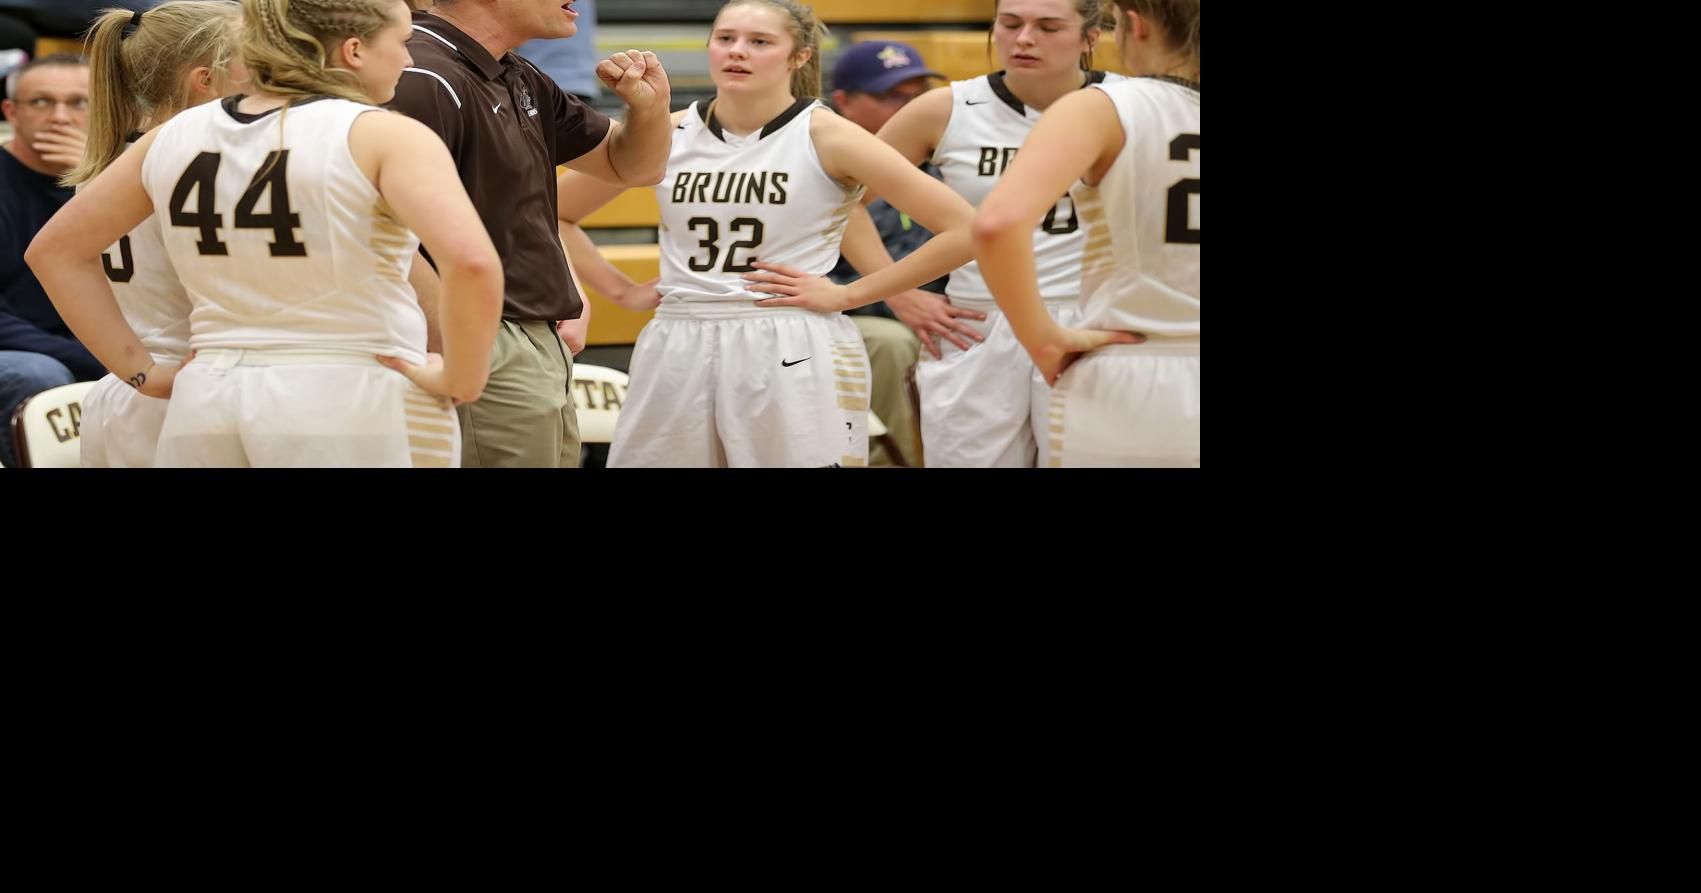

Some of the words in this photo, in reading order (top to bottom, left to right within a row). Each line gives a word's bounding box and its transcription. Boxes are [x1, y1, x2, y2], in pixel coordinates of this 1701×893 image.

[168, 149, 308, 257] 44
[671, 171, 789, 205] BRUINS
[687, 216, 764, 273] 32
